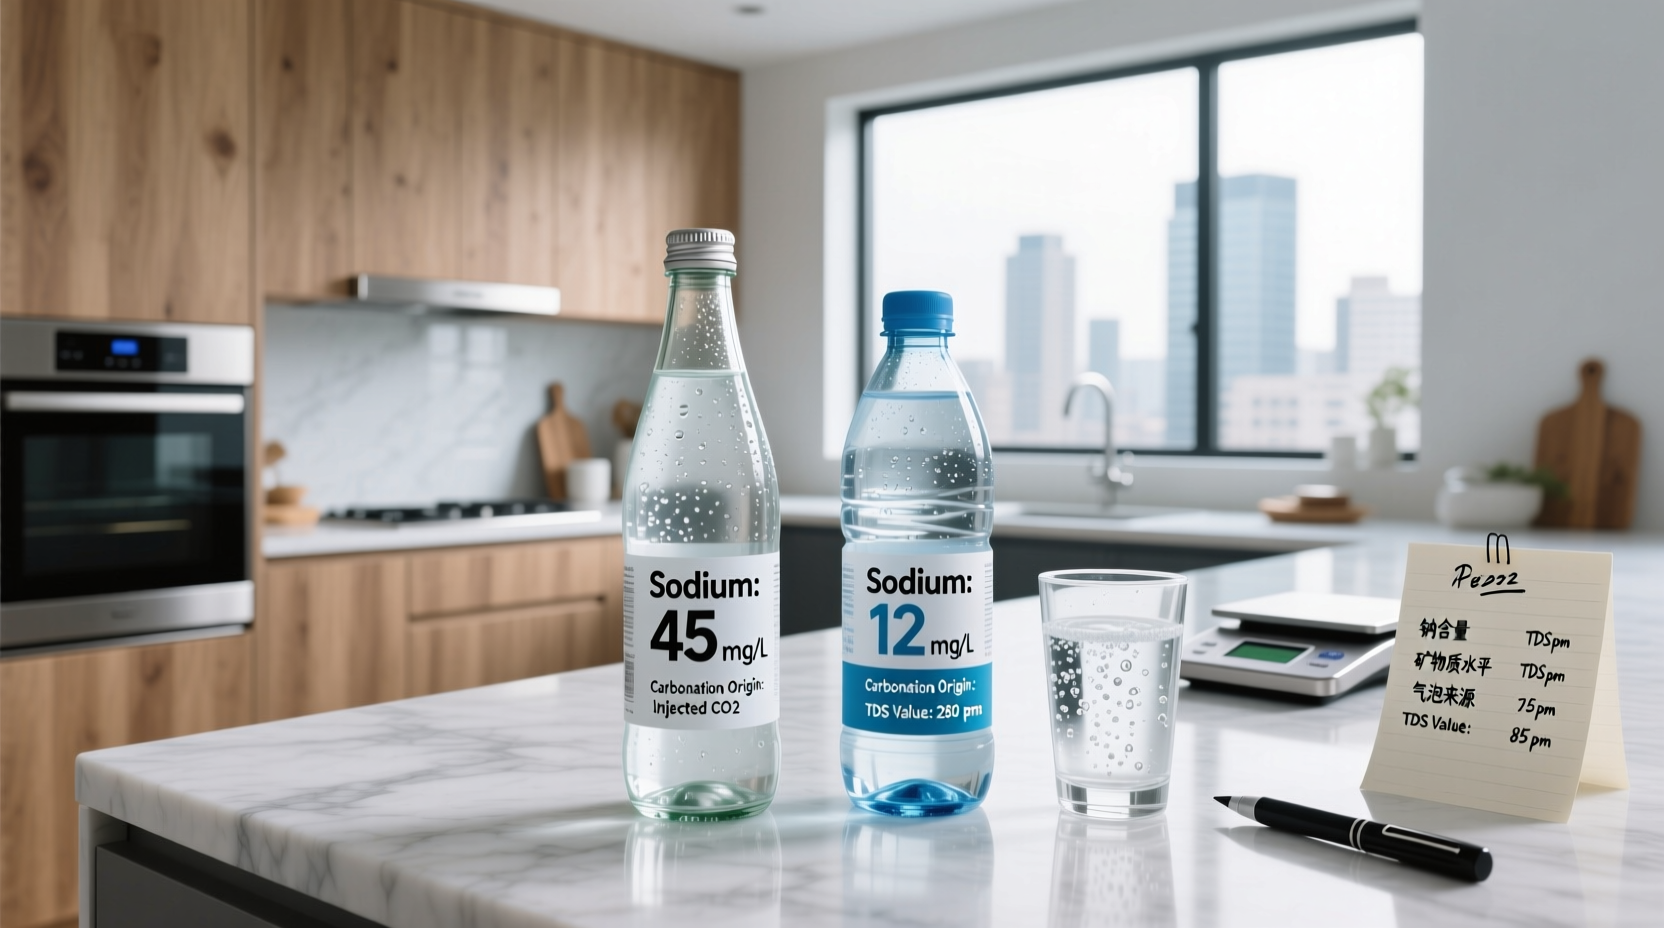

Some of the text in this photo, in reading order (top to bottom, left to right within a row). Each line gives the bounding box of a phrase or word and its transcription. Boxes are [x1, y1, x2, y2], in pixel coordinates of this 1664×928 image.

[650, 571, 760, 599] Sodium:
[867, 567, 973, 595] Sodium:
[651, 610, 768, 665] 45 mg/L
[870, 603, 925, 656] 12
[931, 633, 974, 660] mg/L
[1419, 618, 1470, 641] 钠含量
[1414, 651, 1493, 677] 矿物质水平
[651, 677, 764, 697] Carbonation Origin:
[938, 678, 976, 696] Origin:
[1412, 681, 1476, 709] 气泡来源
[654, 700, 740, 719] Injected CO2
[865, 703, 890, 719] TDS
[893, 705, 933, 719] Value:
[1403, 712, 1428, 728] TDS
[1432, 715, 1471, 734] Value:
